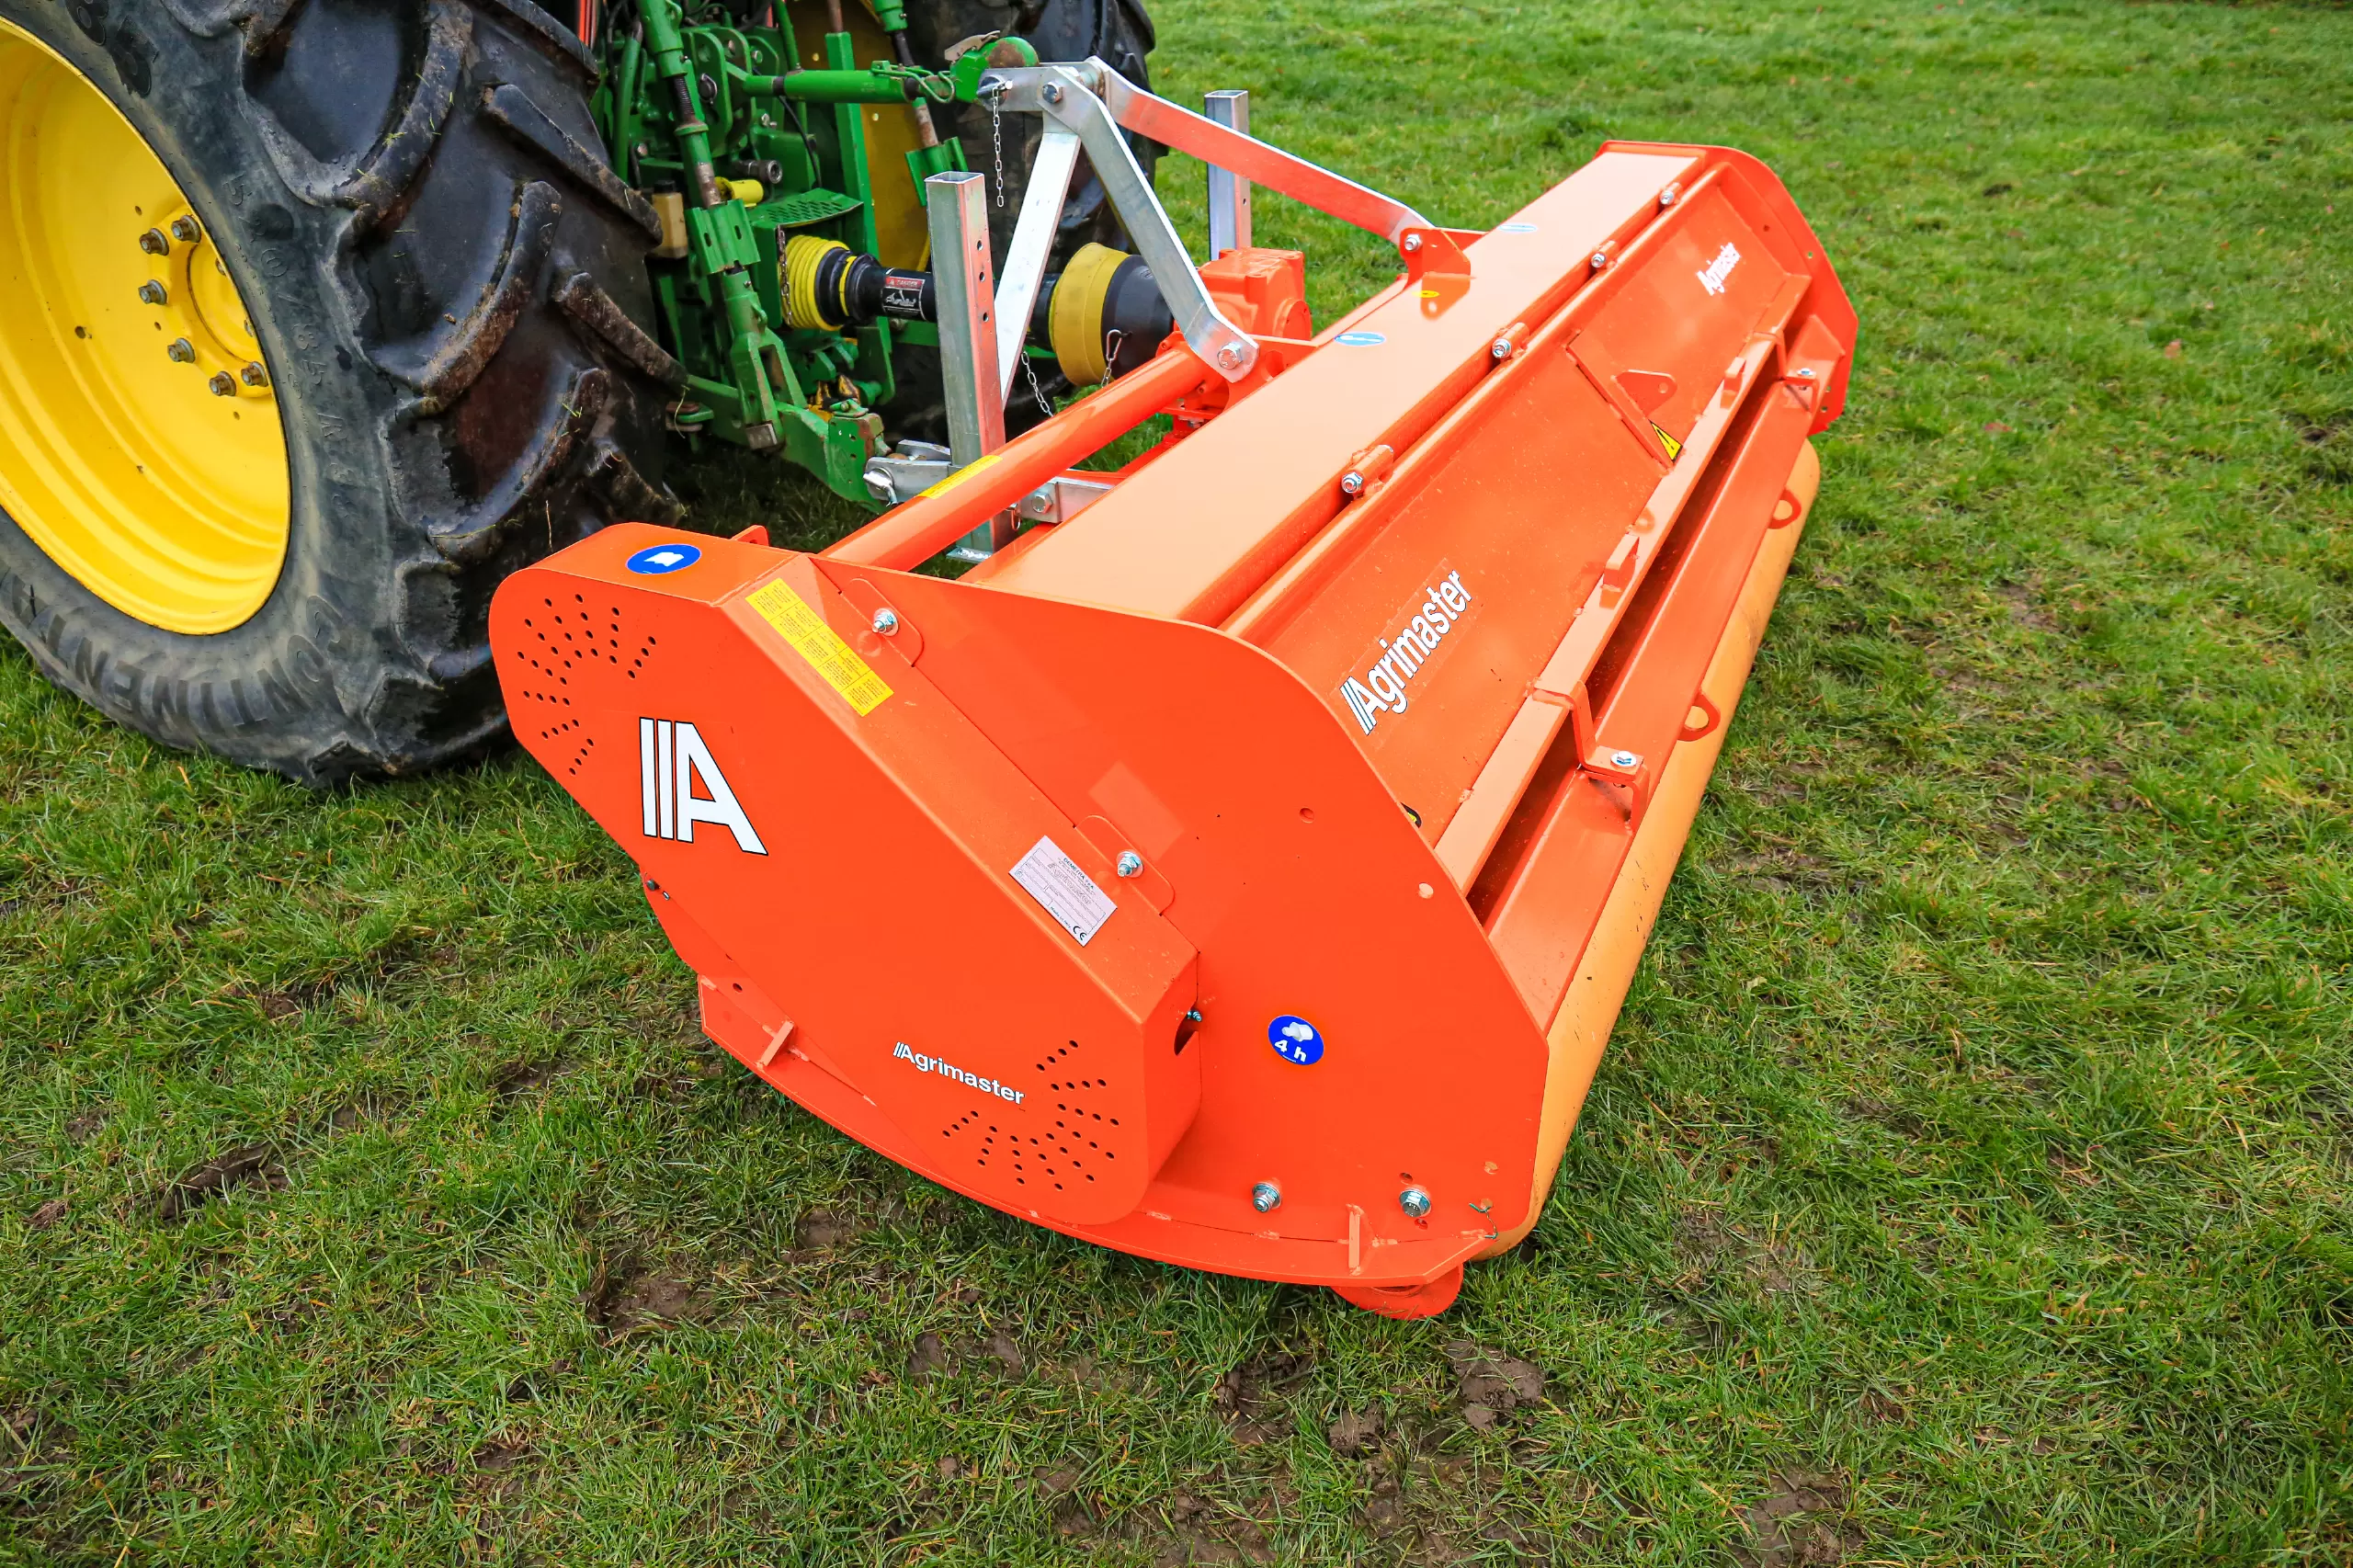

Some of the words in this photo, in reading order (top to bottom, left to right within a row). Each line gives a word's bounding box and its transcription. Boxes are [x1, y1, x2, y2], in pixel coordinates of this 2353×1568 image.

[1695, 242, 1742, 296] Agrimaster
[0, 566, 347, 737] CONTINENTA
[1339, 569, 1472, 736] Agrimaster
[892, 1040, 1026, 1105] Agrimaster
[1274, 1040, 1289, 1053] 4
[1293, 1046, 1307, 1062] h
